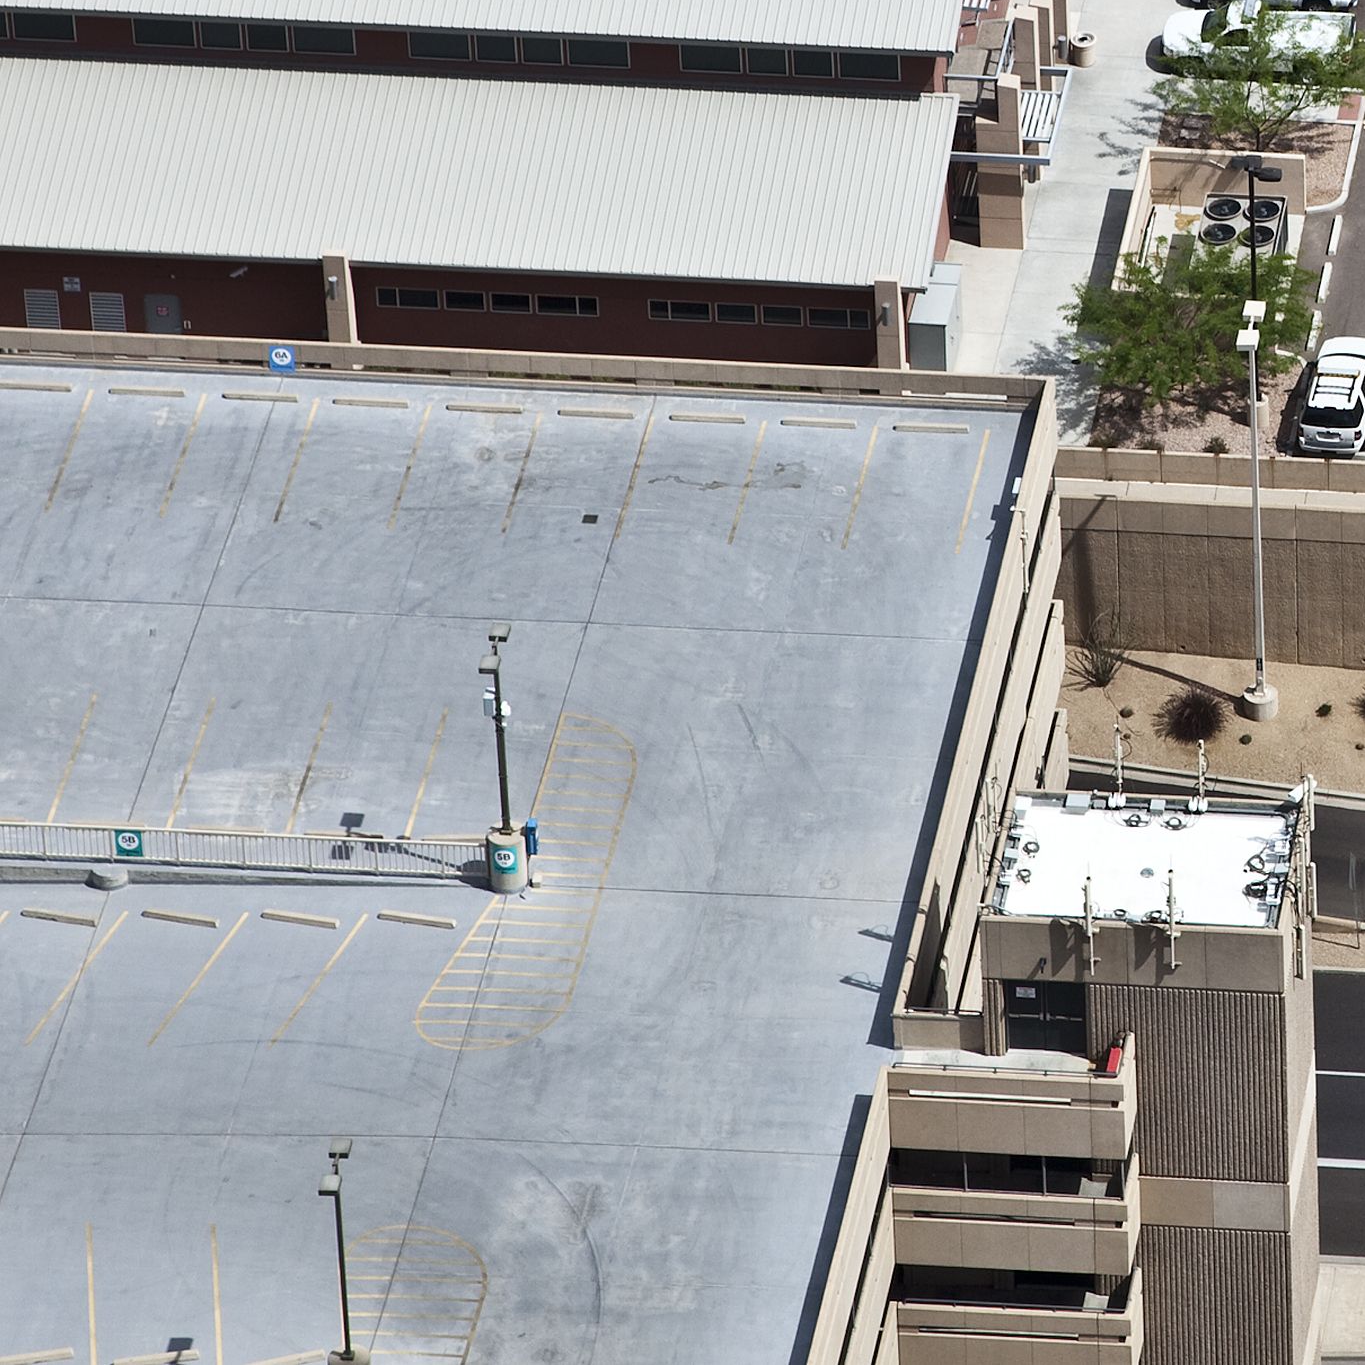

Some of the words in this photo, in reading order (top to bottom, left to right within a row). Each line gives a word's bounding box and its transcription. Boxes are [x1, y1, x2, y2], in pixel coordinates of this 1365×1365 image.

[274, 350, 288, 359] 6A
[121, 835, 136, 844] 5B
[496, 852, 511, 861] 5B
